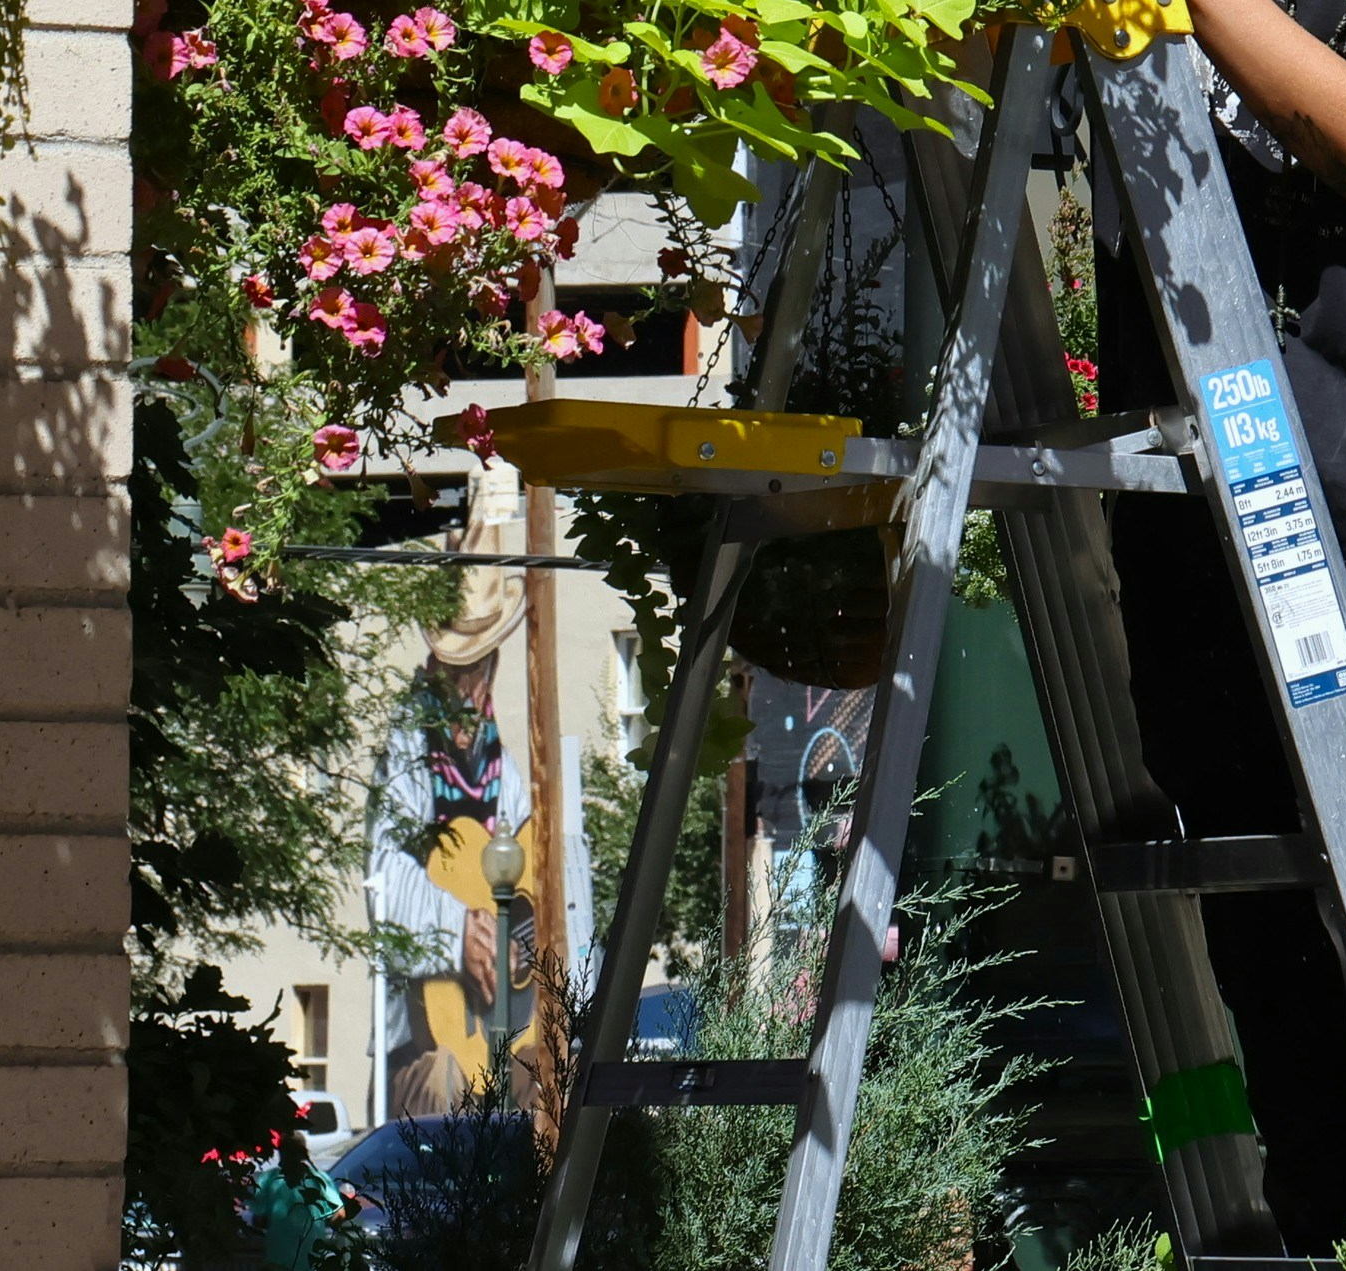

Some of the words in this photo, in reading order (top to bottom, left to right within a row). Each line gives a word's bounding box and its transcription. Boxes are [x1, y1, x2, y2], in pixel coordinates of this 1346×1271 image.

[1208, 369, 1271, 410] 250lb
[1223, 412, 1255, 448] 113
[1255, 417, 1280, 441] kg
[1296, 486, 1304, 494] m
[1238, 499, 1252, 511] 8ft
[1305, 517, 1313, 526] m
[1247, 529, 1263, 543] 12ft
[1264, 527, 1278, 538] 3in
[1314, 548, 1322, 556] m
[1257, 562, 1269, 574] 5ft
[1271, 559, 1285, 569] 8in
